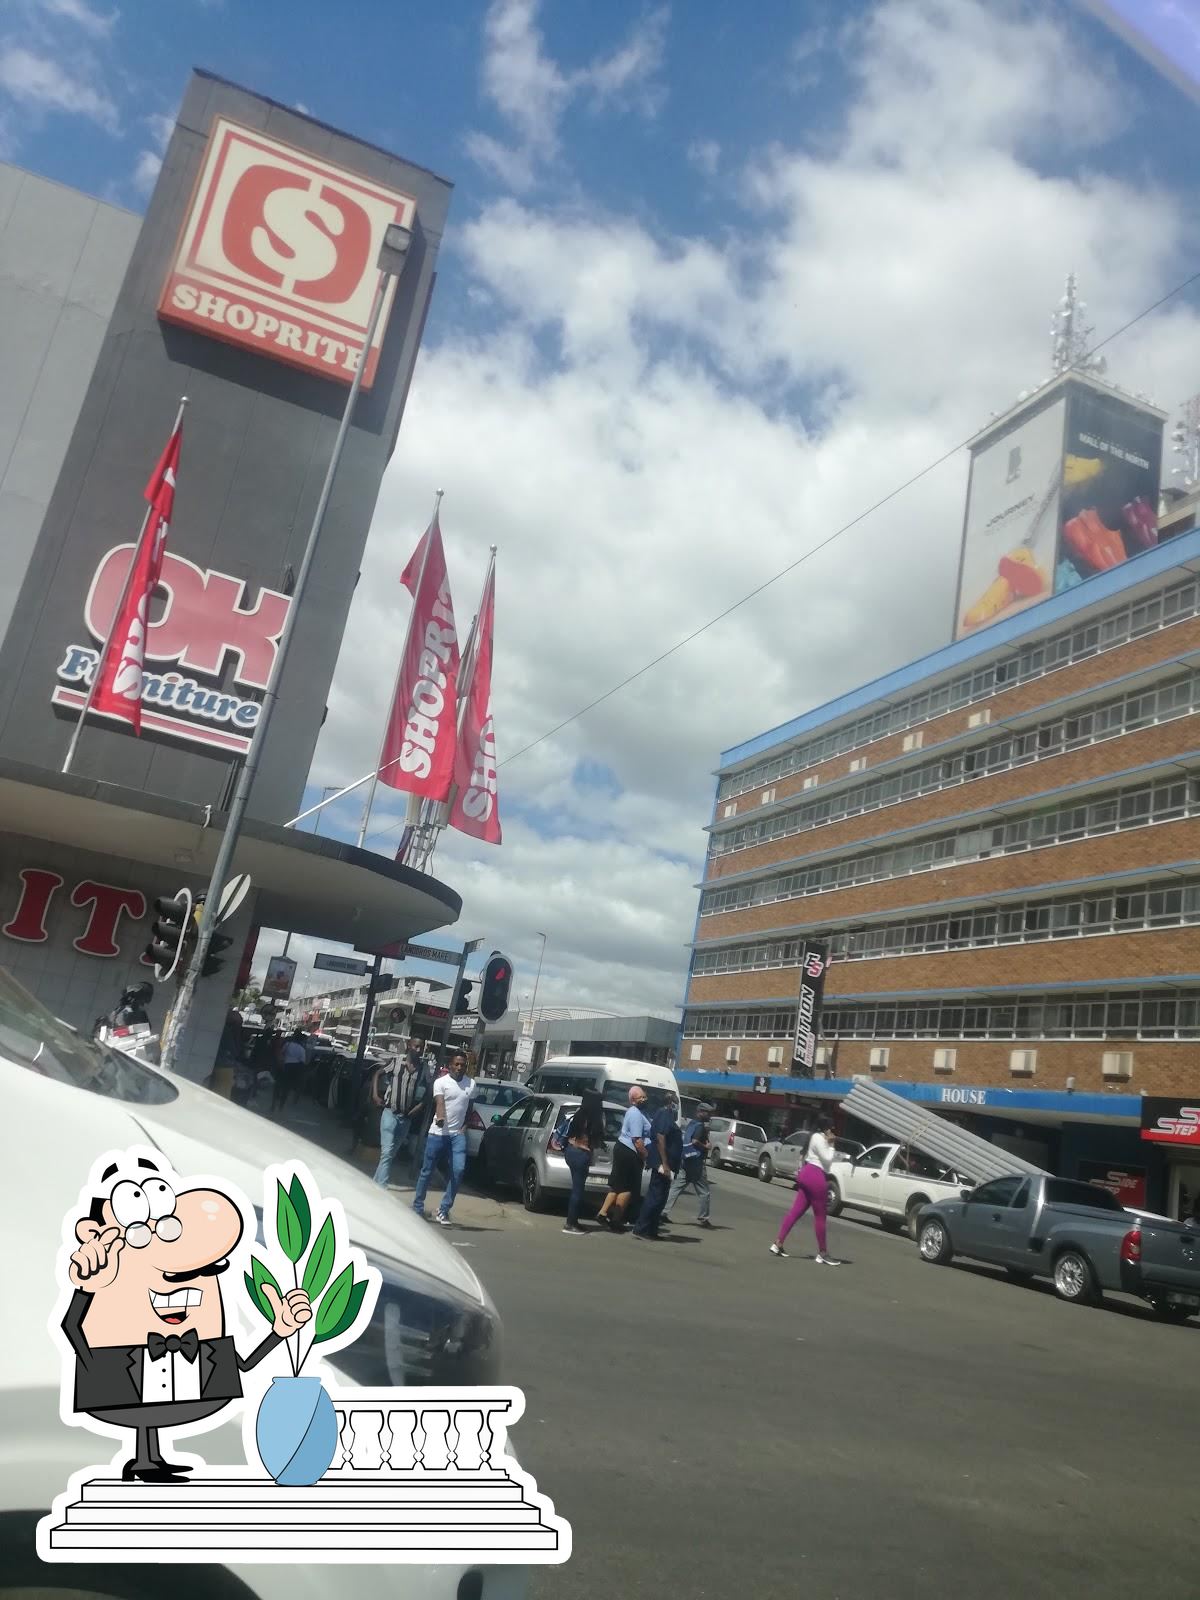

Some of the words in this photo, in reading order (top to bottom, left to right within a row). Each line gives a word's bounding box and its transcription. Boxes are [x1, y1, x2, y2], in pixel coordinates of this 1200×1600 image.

[172, 283, 368, 373] SHOPRITE
[84, 542, 294, 690] OK
[57, 644, 262, 728] Fniture
[794, 983, 815, 1062] EDITION
[941, 1088, 986, 1105] HOUSE
[1149, 1117, 1198, 1136] STEP
[1107, 1171, 1137, 1189] SIDE
